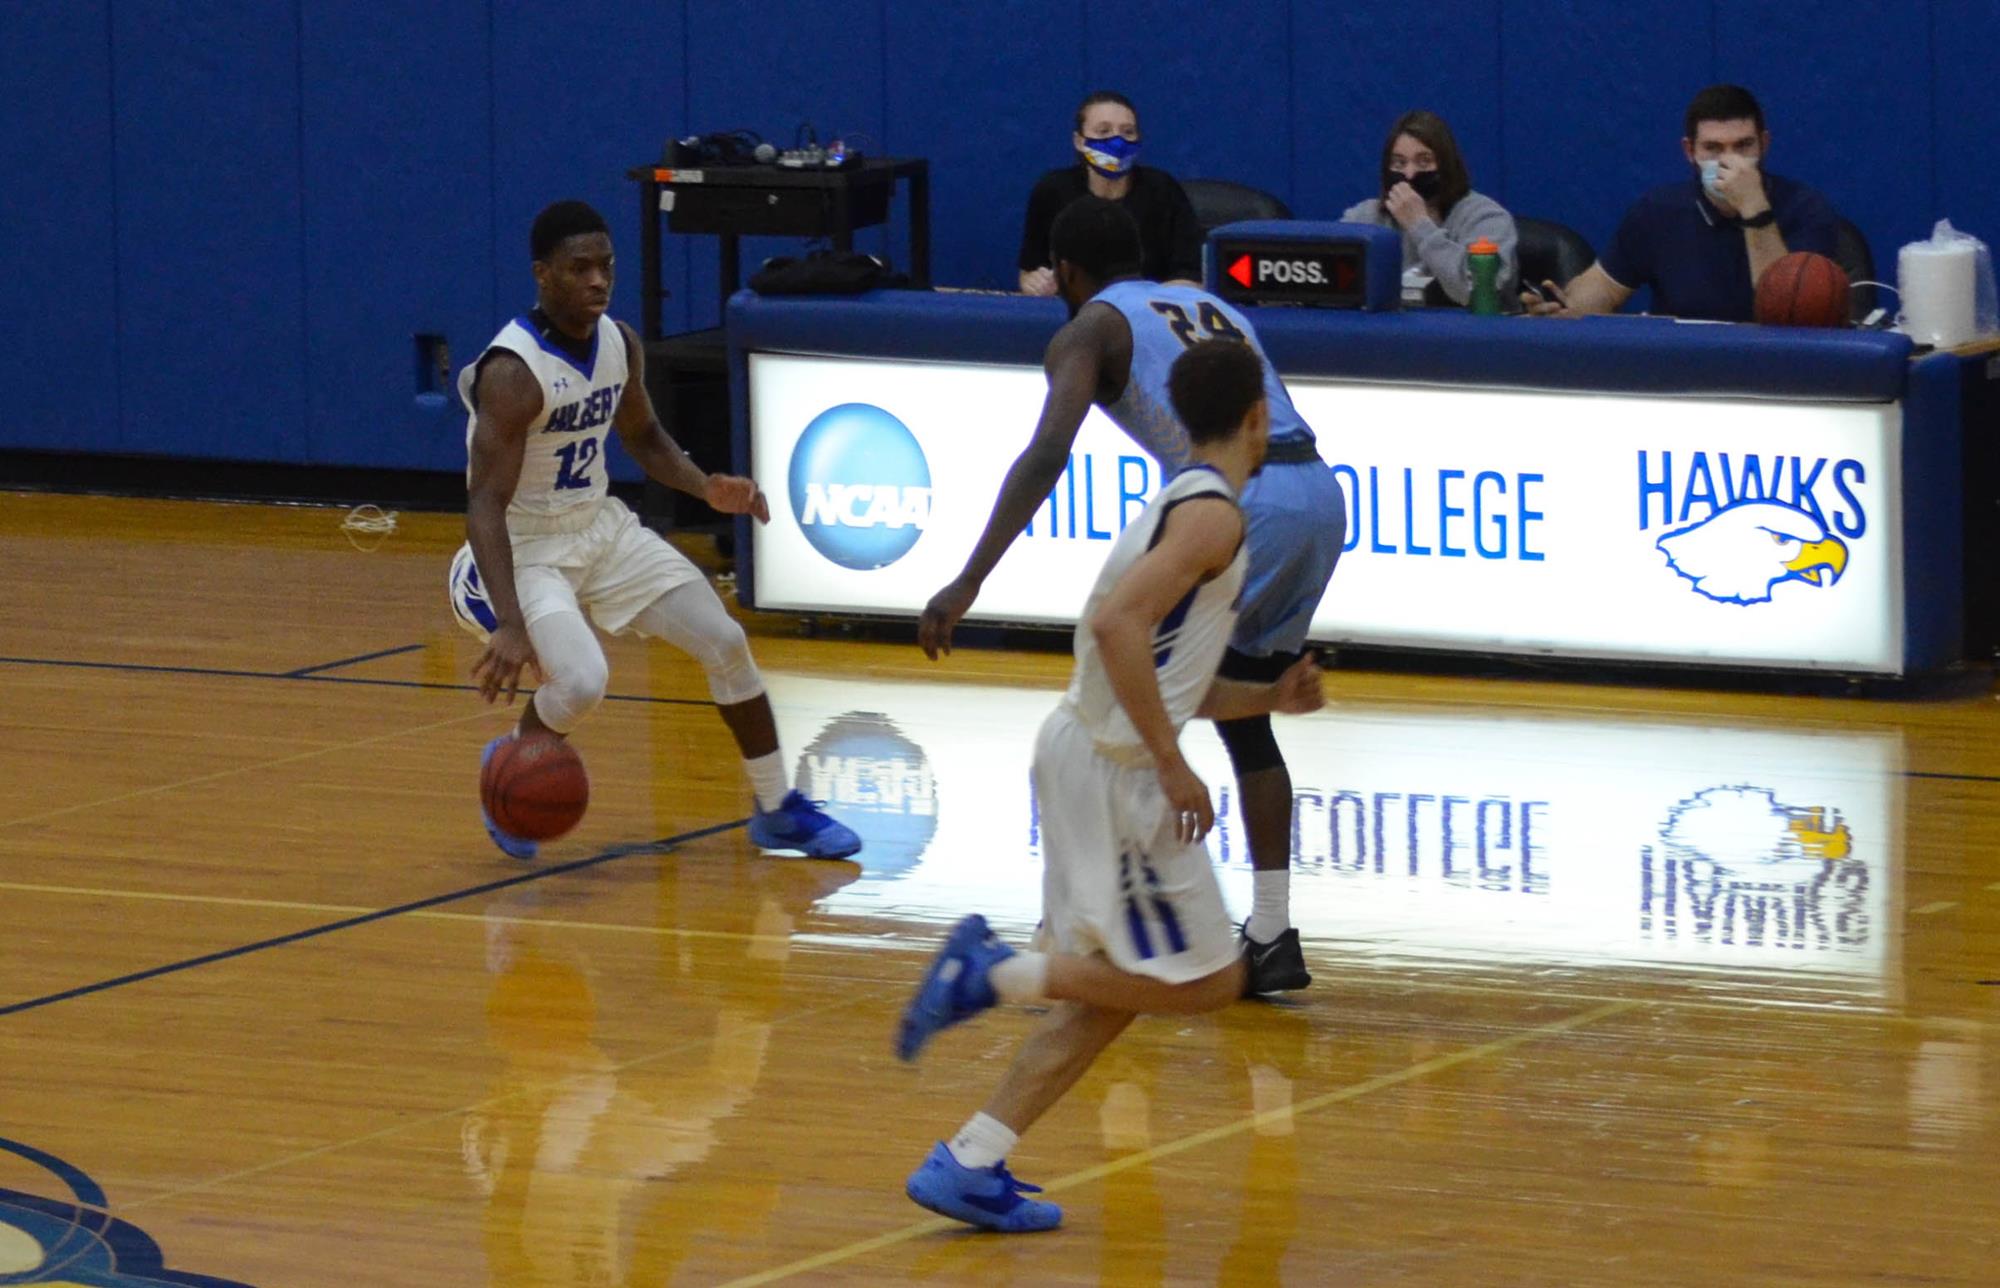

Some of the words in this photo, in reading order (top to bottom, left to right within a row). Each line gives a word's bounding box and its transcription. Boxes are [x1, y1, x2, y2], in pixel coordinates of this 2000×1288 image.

[1258, 260, 1328, 284] POSS.
[1147, 300, 1248, 345] 24
[553, 437, 597, 491] 12
[802, 483, 932, 530] NCAA
[1330, 464, 1545, 561] OLLEGE
[1637, 449, 1867, 540] HAWKS
